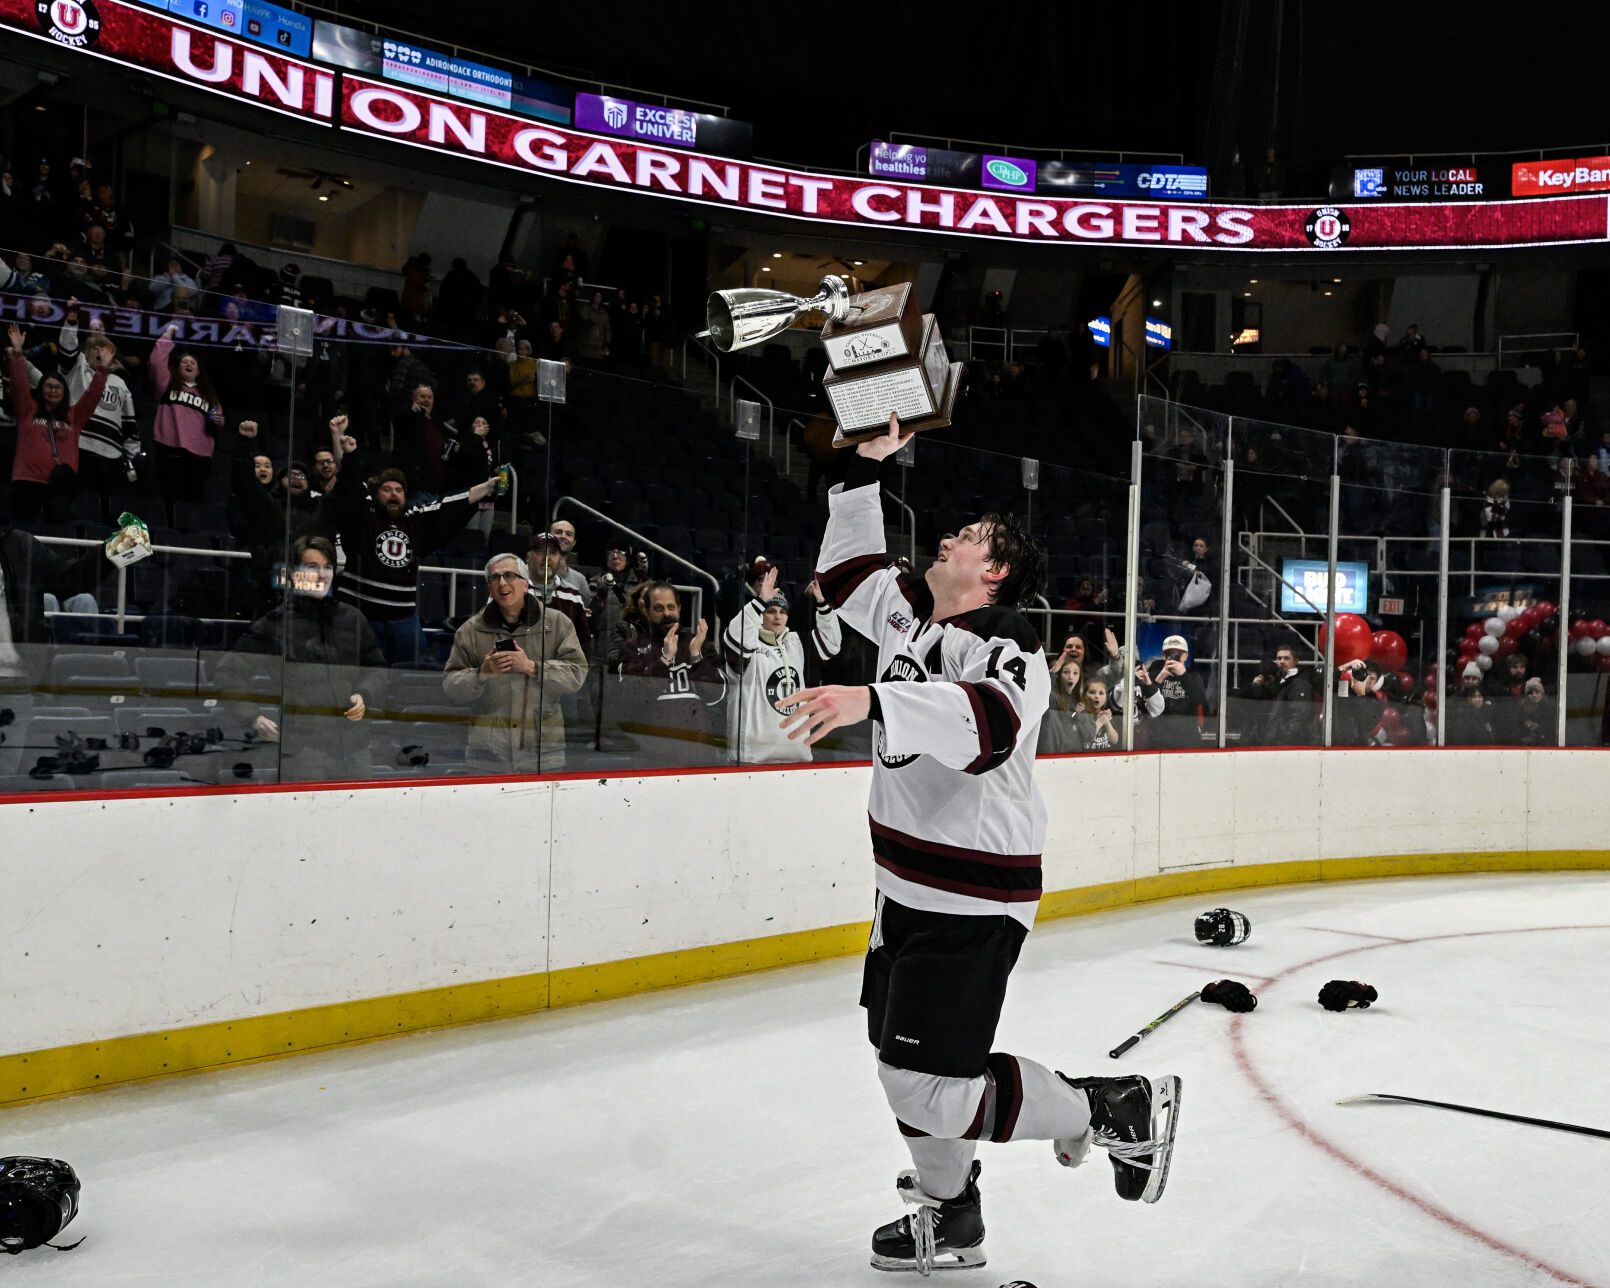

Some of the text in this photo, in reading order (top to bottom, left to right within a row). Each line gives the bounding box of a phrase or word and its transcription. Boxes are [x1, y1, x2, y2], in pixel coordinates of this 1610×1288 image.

[278, 15, 306, 32] Honda
[48, 26, 88, 46] HOCKEY
[425, 56, 472, 78] ADIRONDACK
[171, 27, 487, 153] UNION
[513, 128, 833, 213] GARNET
[851, 186, 1254, 244] CHARGERS
[1137, 172, 1186, 190] CDTA
[1394, 169, 1474, 182] YOUR LOCAL
[1393, 183, 1483, 196] NEWS LEADER
[169, 390, 209, 413] UNION
[1383, 600, 1402, 613] EXIT
[985, 645, 1027, 692] 14
[767, 688, 775, 696] 17
[895, 1034, 920, 1045] BAUER
